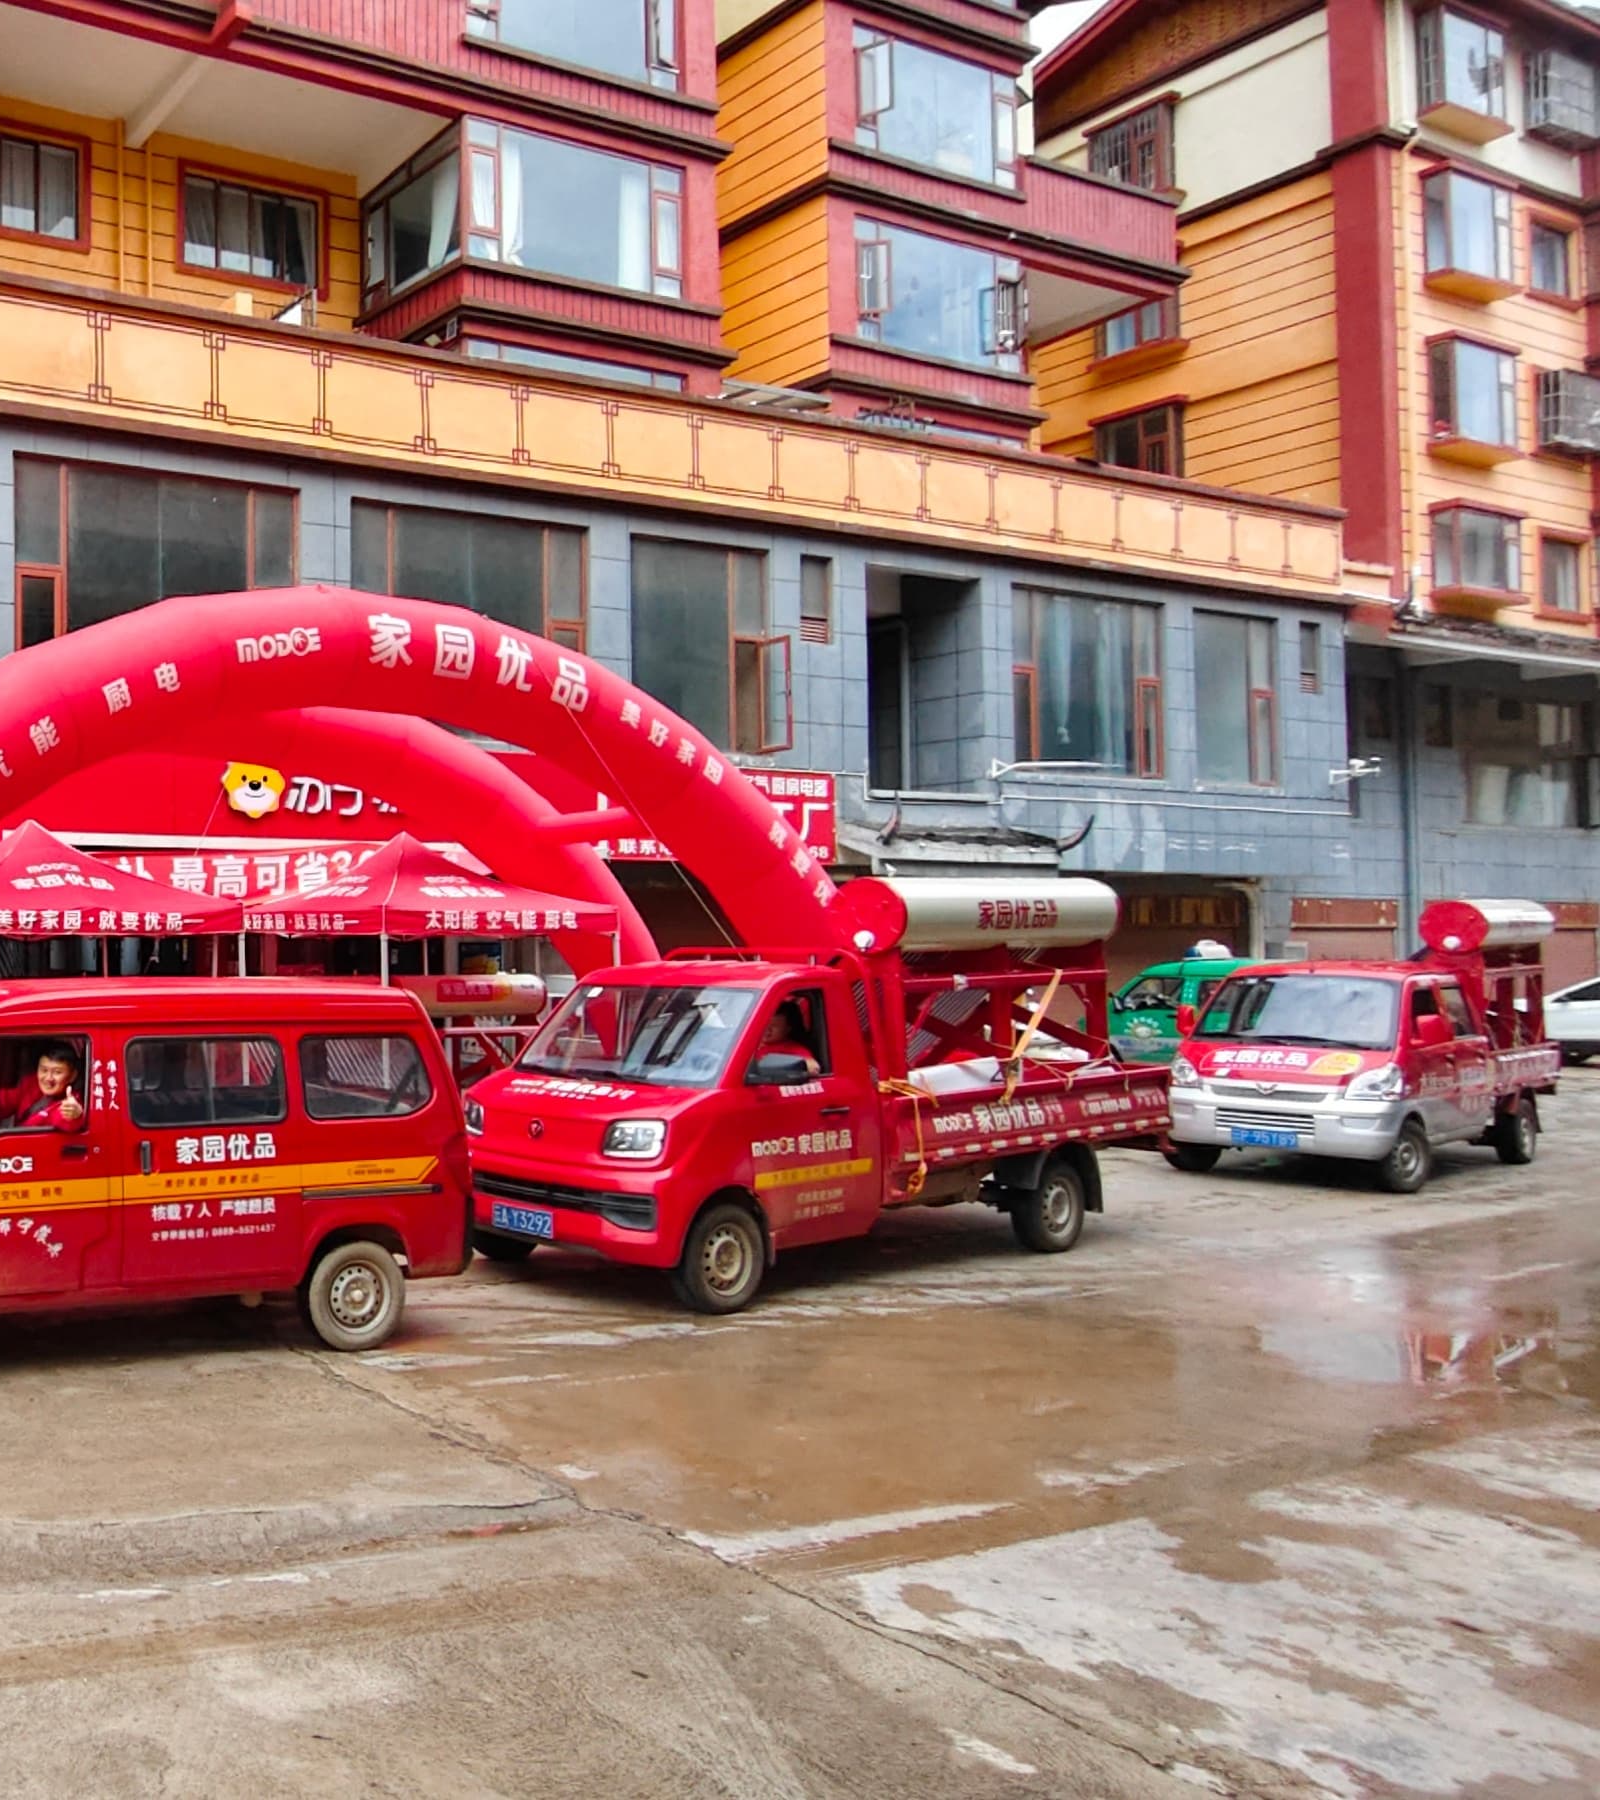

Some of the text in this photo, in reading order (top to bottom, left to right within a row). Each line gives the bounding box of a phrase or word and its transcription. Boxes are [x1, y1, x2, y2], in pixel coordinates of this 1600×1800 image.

[367, 612, 590, 713] 家园优品
[102, 662, 182, 715] 厨电
[620, 699, 724, 786] 美好家园
[10, 873, 115, 891] 家园优品
[425, 910, 578, 930] 太阳能 空气能 厨电
[977, 899, 1048, 930] 家园优品
[1213, 1050, 1308, 1067] 家园优品
[973, 1096, 1045, 1134] 家园优品
[175, 1132, 277, 1164] 家园优品
[798, 1129, 853, 1155] 家园优品
